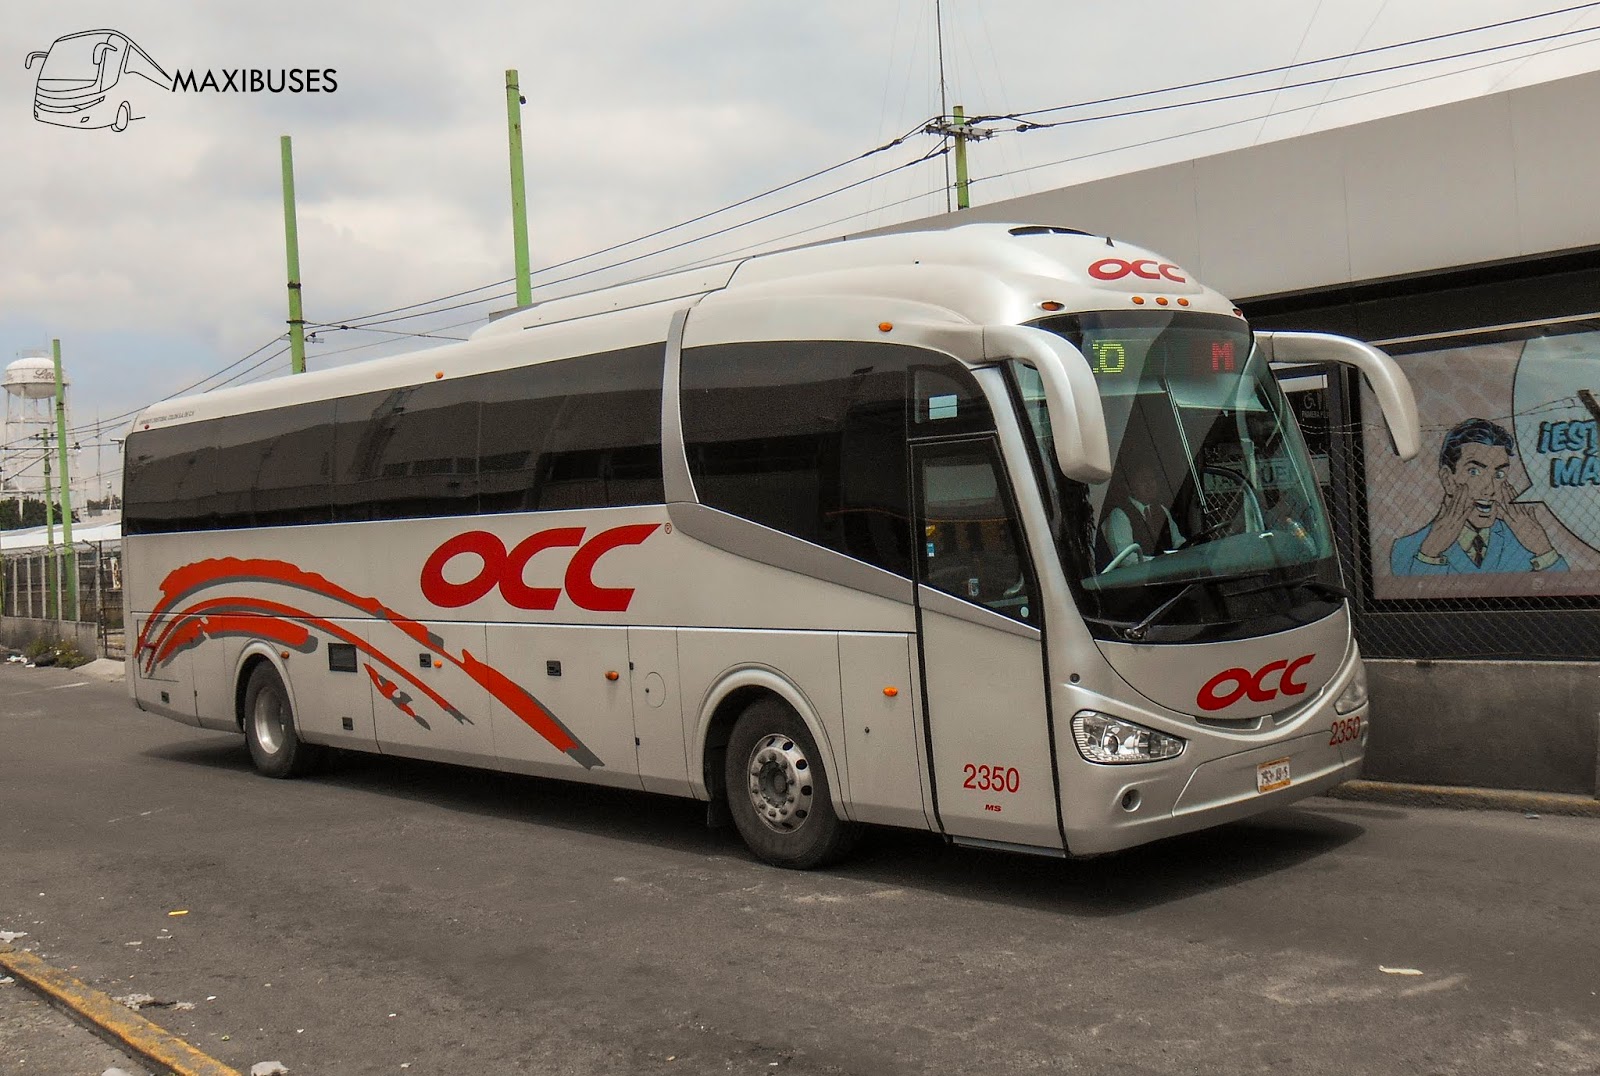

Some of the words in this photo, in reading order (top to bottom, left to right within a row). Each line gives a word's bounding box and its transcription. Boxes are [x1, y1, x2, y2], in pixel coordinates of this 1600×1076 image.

[1088, 258, 1186, 284] OCC
[420, 523, 662, 612] OCC
[1196, 653, 1316, 711] OCC
[1329, 716, 1360, 746] 2350
[963, 763, 1020, 793] 2350
[984, 804, 1002, 812] MS
